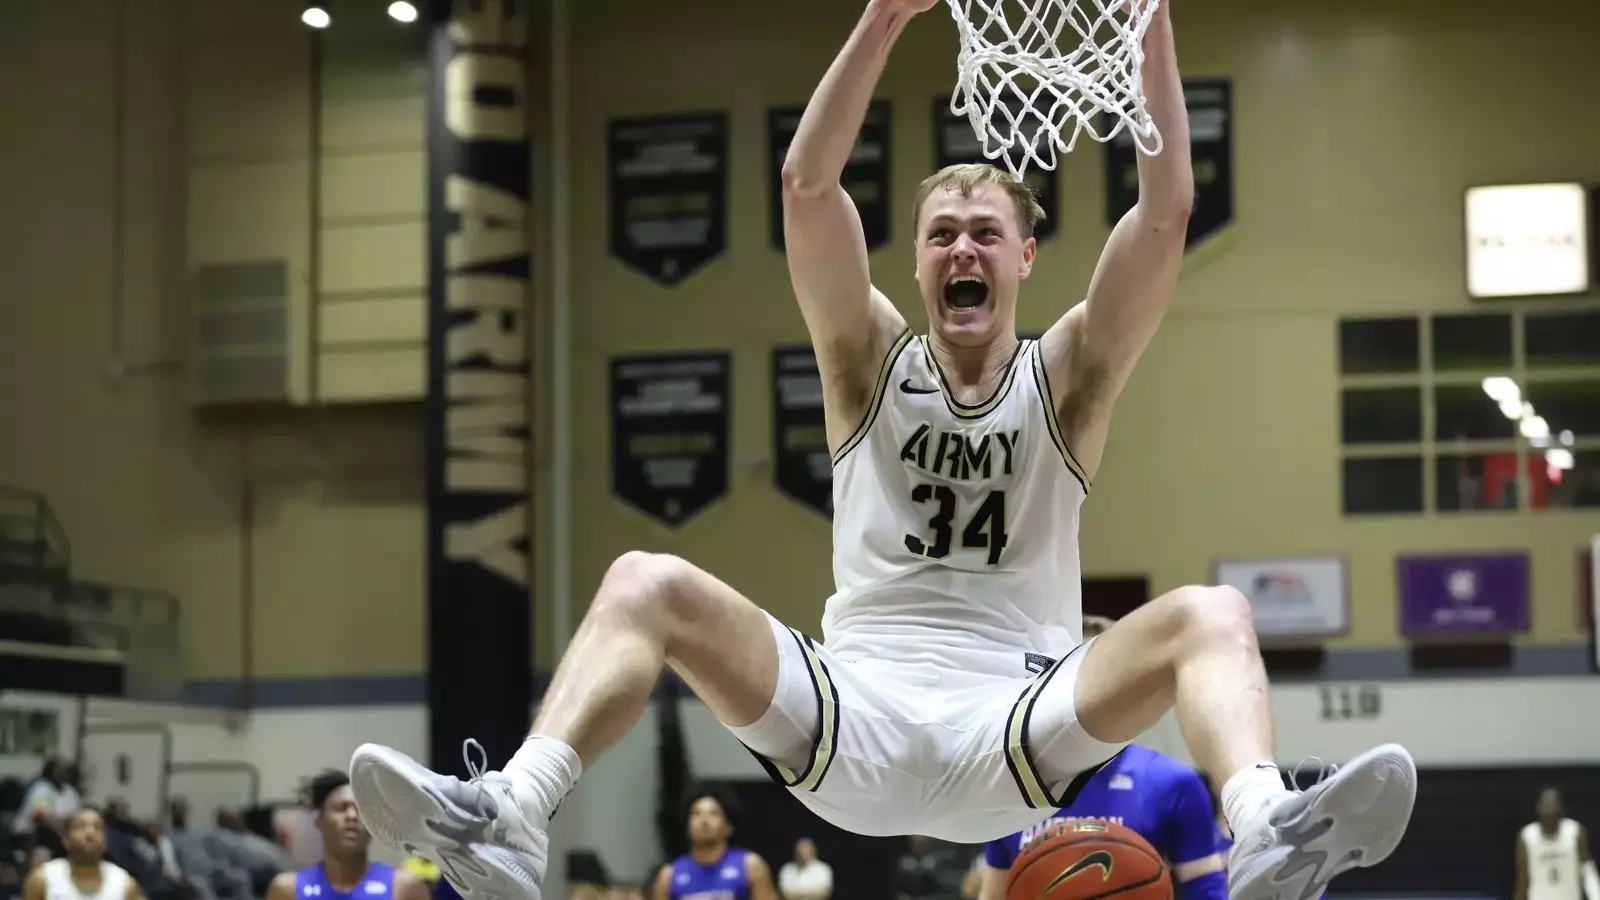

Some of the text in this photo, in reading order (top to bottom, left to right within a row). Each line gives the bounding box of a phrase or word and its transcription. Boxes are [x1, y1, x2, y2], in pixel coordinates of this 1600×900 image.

[443, 173, 530, 587] ARMY
[900, 423, 1020, 480] ARMY
[904, 484, 1008, 565] 34
